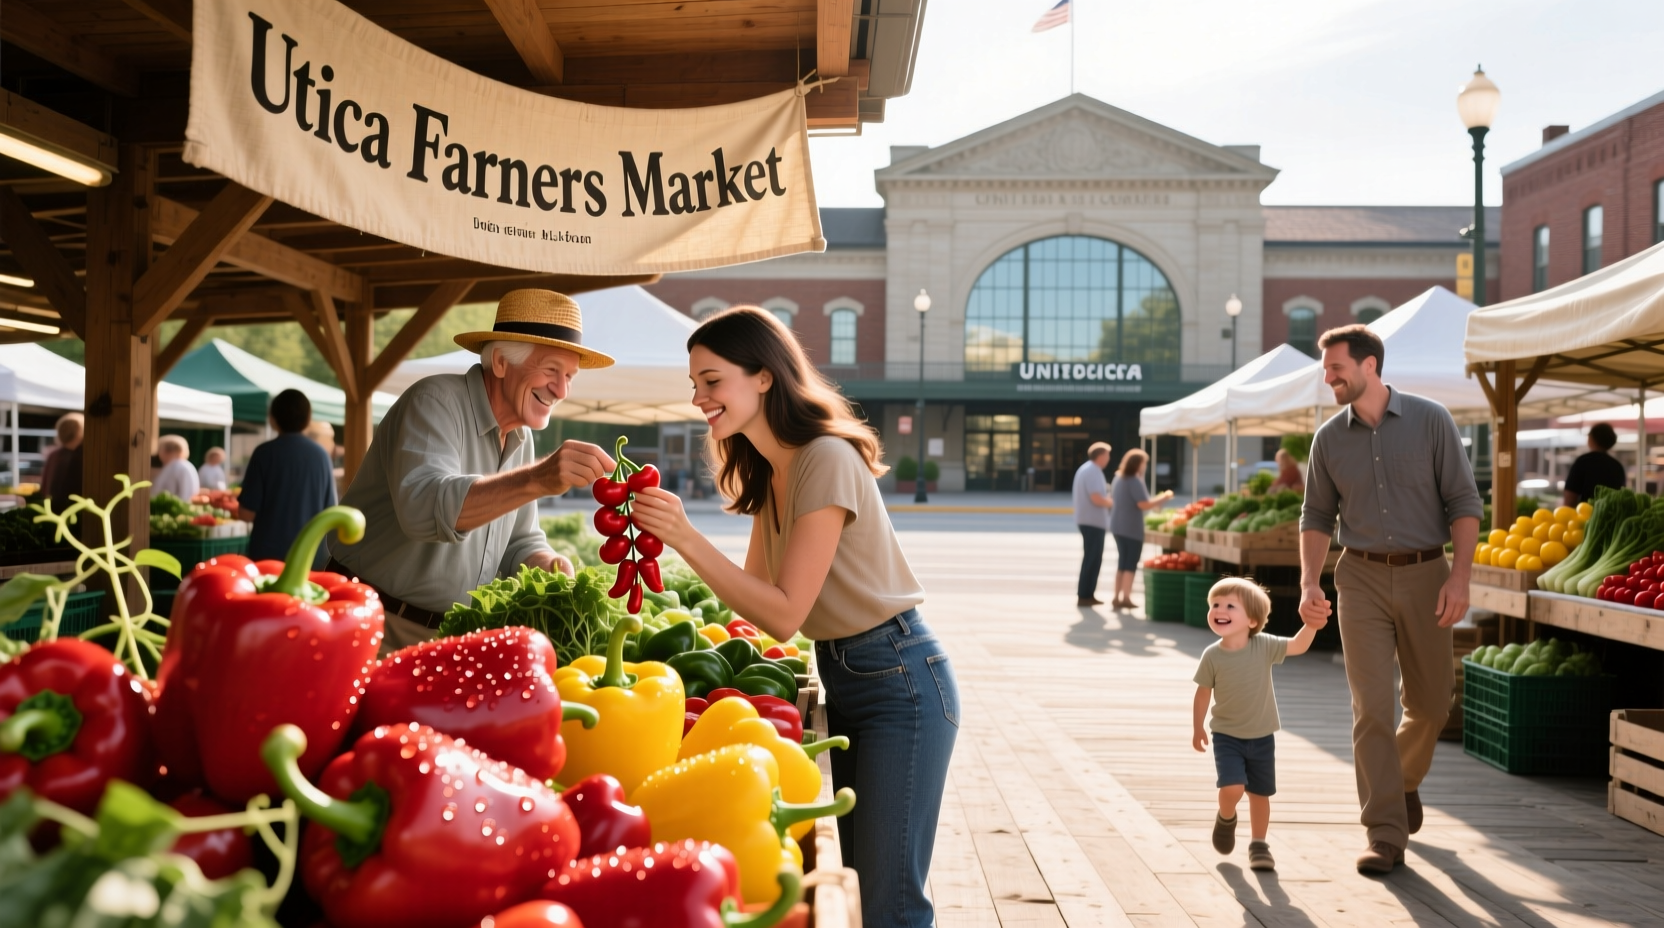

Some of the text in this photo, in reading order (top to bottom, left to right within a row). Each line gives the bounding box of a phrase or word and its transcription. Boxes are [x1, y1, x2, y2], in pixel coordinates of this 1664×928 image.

[248, 11, 787, 217] Utica Farners Market
